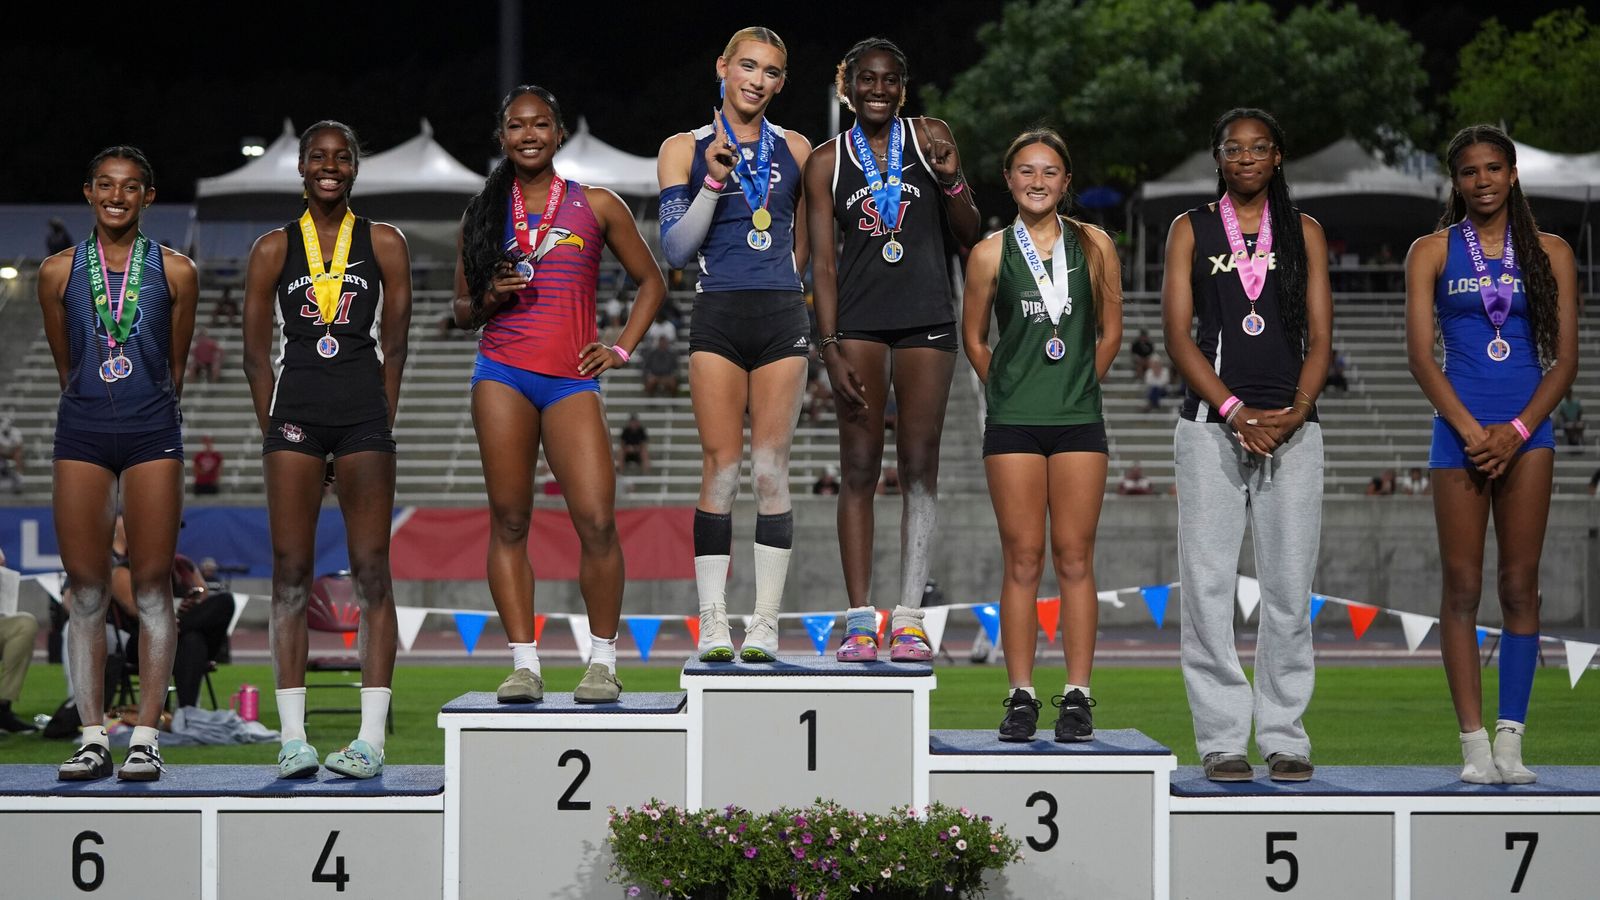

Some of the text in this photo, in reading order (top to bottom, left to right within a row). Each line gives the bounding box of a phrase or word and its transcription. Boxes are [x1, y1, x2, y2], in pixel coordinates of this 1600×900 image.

[853, 132, 877, 178] 2024-2025
[302, 220, 321, 269] 2024-2025
[1221, 202, 1241, 246] 2024-2025
[1462, 225, 1486, 272] 2024-2025
[87, 242, 103, 291] 2024-2025
[1016, 227, 1042, 272] 2024-2025
[287, 274, 317, 296] SAIN
[1447, 277, 1480, 296] LOS
[799, 709, 817, 772] 1
[557, 749, 591, 811] 2
[1025, 790, 1059, 853] 3
[71, 830, 105, 893] 6
[311, 830, 350, 892] 4
[1265, 831, 1299, 893] 5
[1505, 831, 1539, 894] 7
